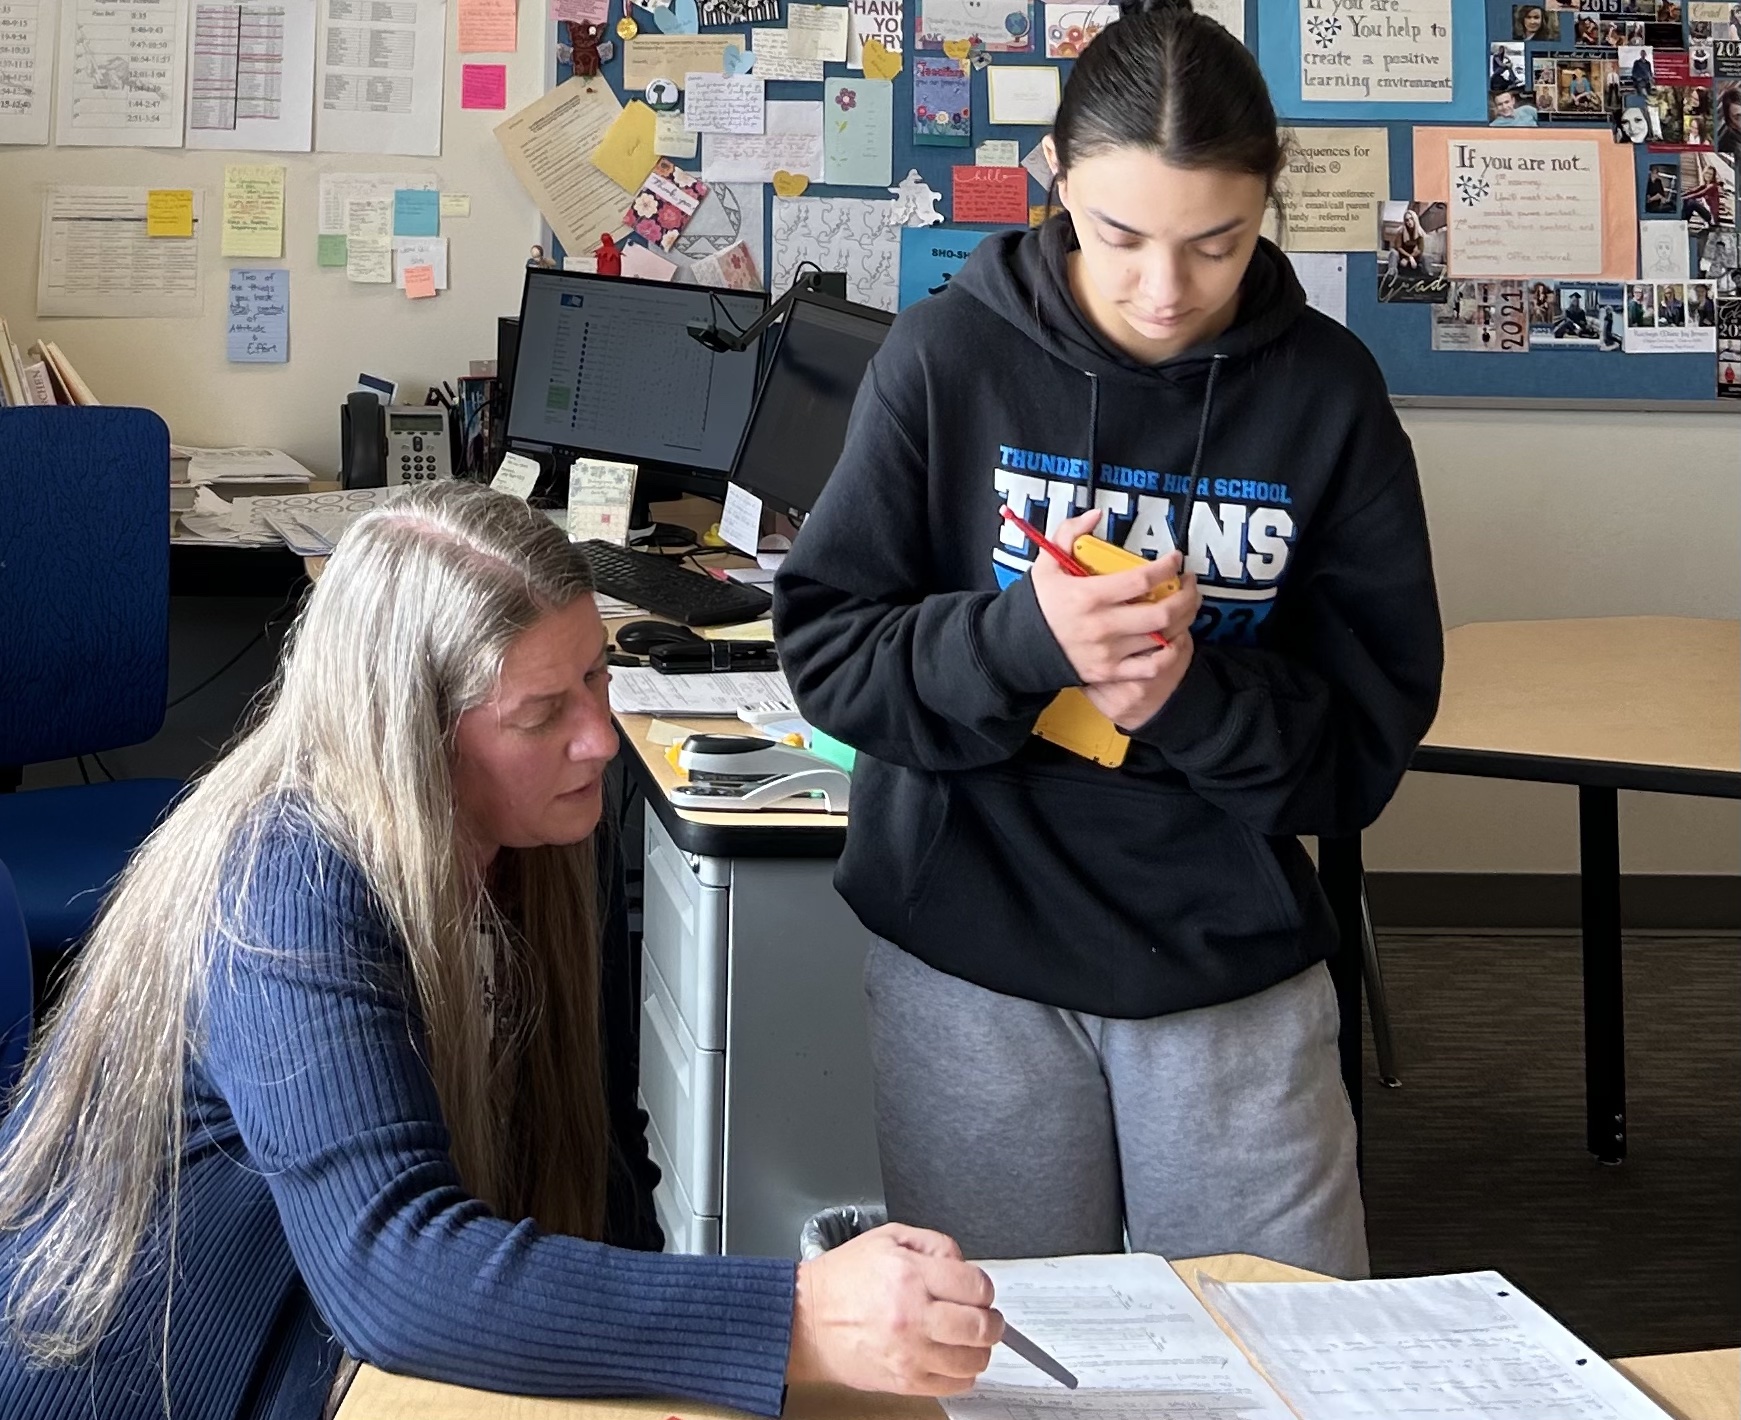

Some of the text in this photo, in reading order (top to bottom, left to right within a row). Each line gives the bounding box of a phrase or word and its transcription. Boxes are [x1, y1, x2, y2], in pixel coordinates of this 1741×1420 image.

[1348, 15, 1447, 43] You help to
[1304, 51, 1439, 72] create a positive
[1304, 69, 1370, 97] learning
[1287, 145, 1370, 159] nsequences for
[1453, 144, 1477, 169] If
[1481, 155, 1512, 178] you
[1518, 157, 1546, 171] are
[1289, 162, 1327, 174] tardies
[238, 271, 275, 281] Two of
[1501, 289, 1525, 350] 2021
[1100, 462, 1160, 491] RIDGE
[1214, 478, 1292, 504] SCHOOL
[994, 467, 1298, 582] TITANS
